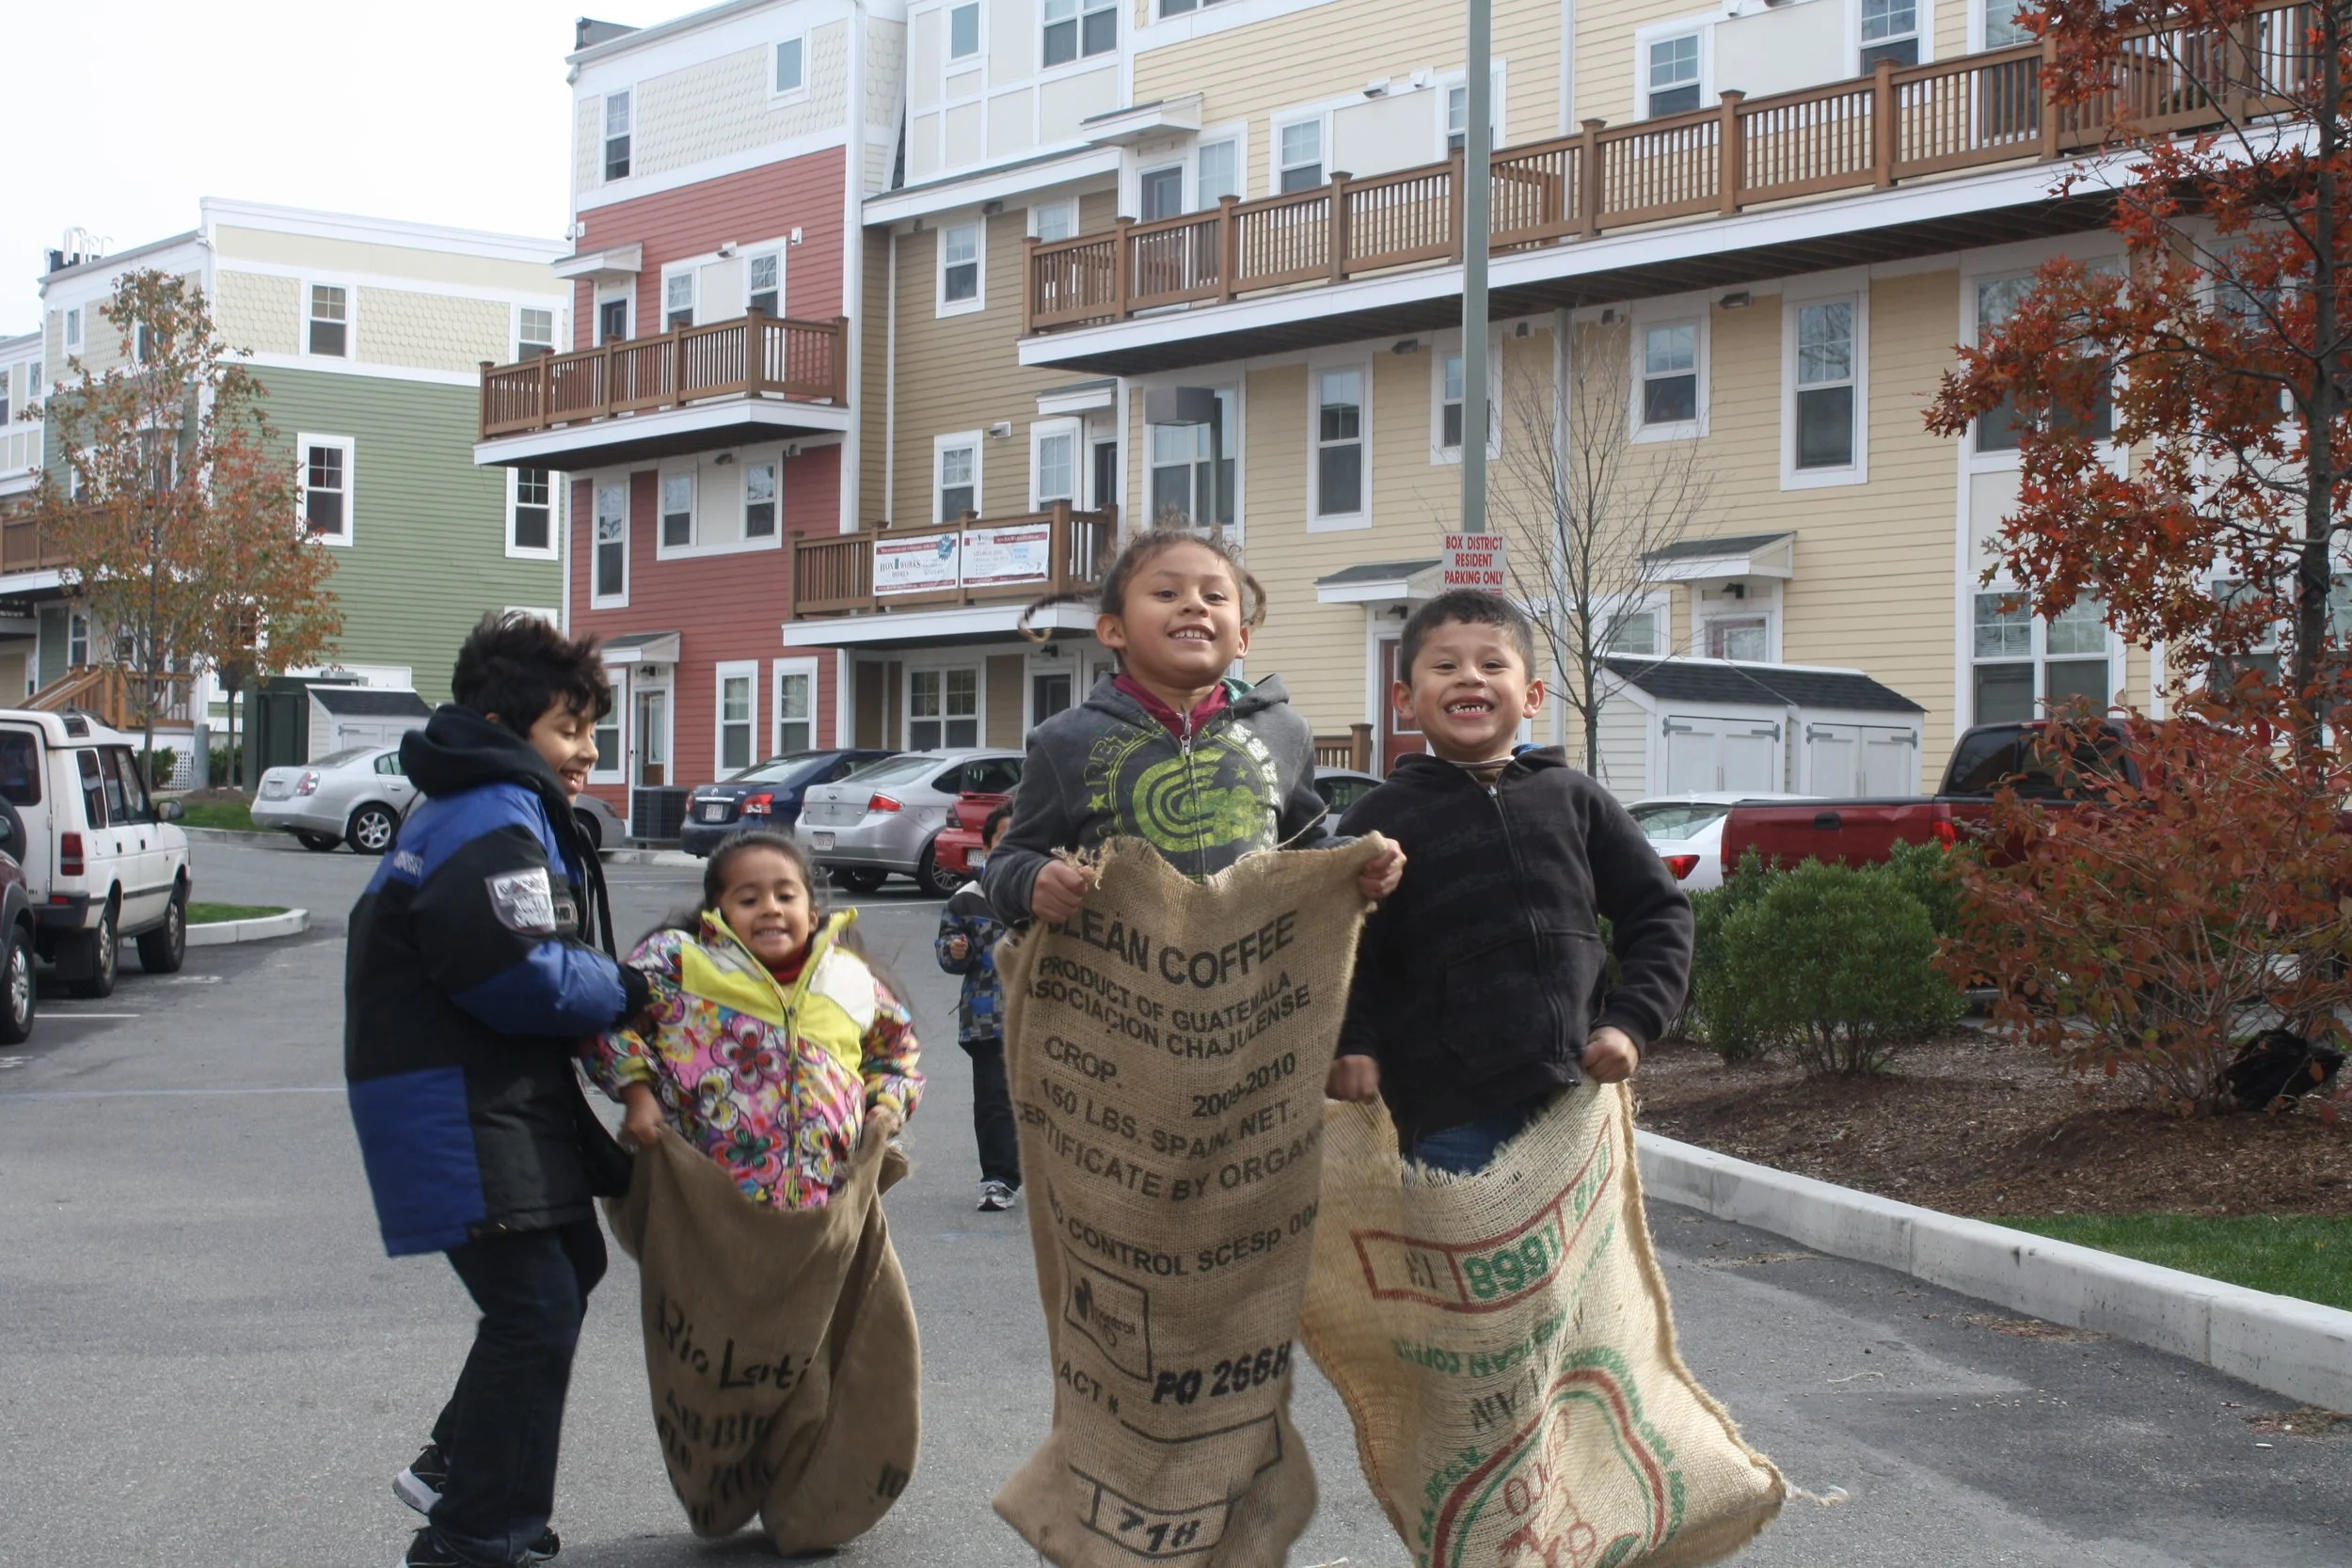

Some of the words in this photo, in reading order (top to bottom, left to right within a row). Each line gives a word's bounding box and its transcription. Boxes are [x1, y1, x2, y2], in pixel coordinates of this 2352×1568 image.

[1446, 535, 1463, 550] BOX
[1468, 536, 1502, 551] DISTRICT
[1455, 553, 1493, 567] RESIDENT
[1445, 570, 1481, 585] PARKING
[1483, 571, 1504, 585] ONLY
[1159, 909, 1299, 989] COFFEE
[1039, 956, 1130, 1009] PRODUCT
[1136, 995, 1165, 1022] OF
[1171, 971, 1292, 1033] GUATEMALA
[1167, 984, 1311, 1060] CHAJULENSE
[1191, 1051, 1296, 1117] 2009-2010
[1170, 1173, 1211, 1202] BY
[1069, 1217, 1189, 1276] CONTROL
[1152, 1370, 1203, 1406] PO
